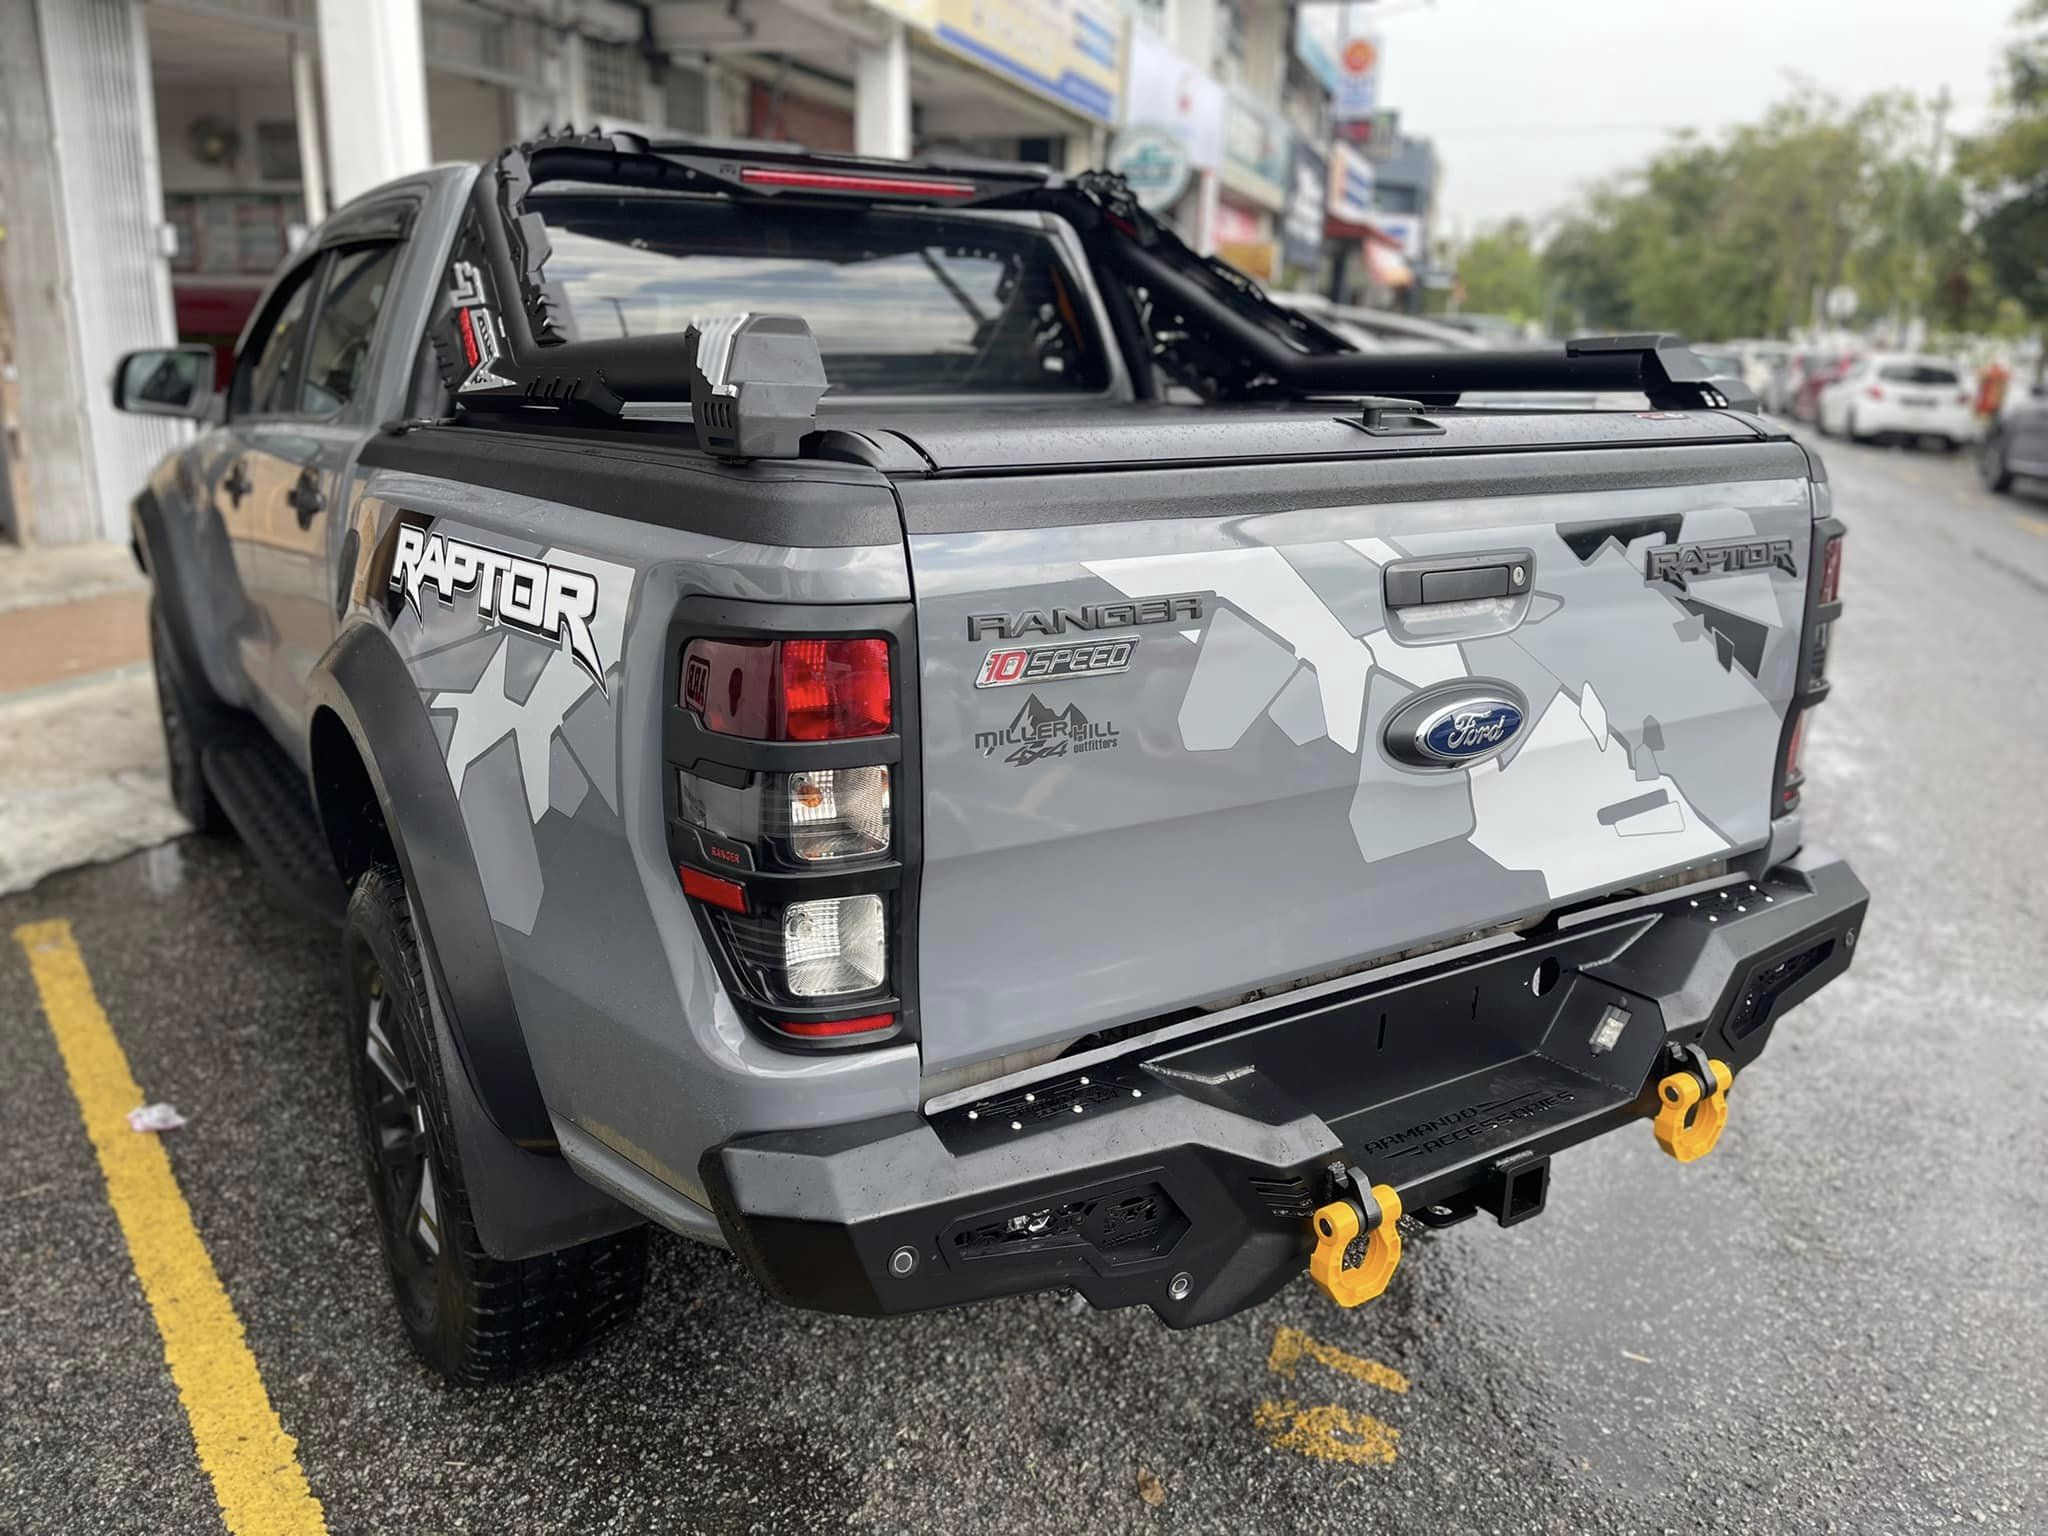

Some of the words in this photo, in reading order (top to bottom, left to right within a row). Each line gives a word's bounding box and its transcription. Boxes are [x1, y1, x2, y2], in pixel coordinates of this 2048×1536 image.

[1645, 539, 1798, 592] RAPTOR
[388, 522, 609, 700] RAPTOR
[967, 599, 1203, 642] RANGER
[984, 650, 1028, 683] 10
[1027, 643, 1133, 676] SPEED
[1072, 721, 1120, 743] HILL
[1447, 710, 1506, 749] Ford
[711, 846, 741, 864] RANGER
[1363, 1106, 1478, 1154] ARMANDO
[1422, 1090, 1576, 1153] ACCESSORIES
